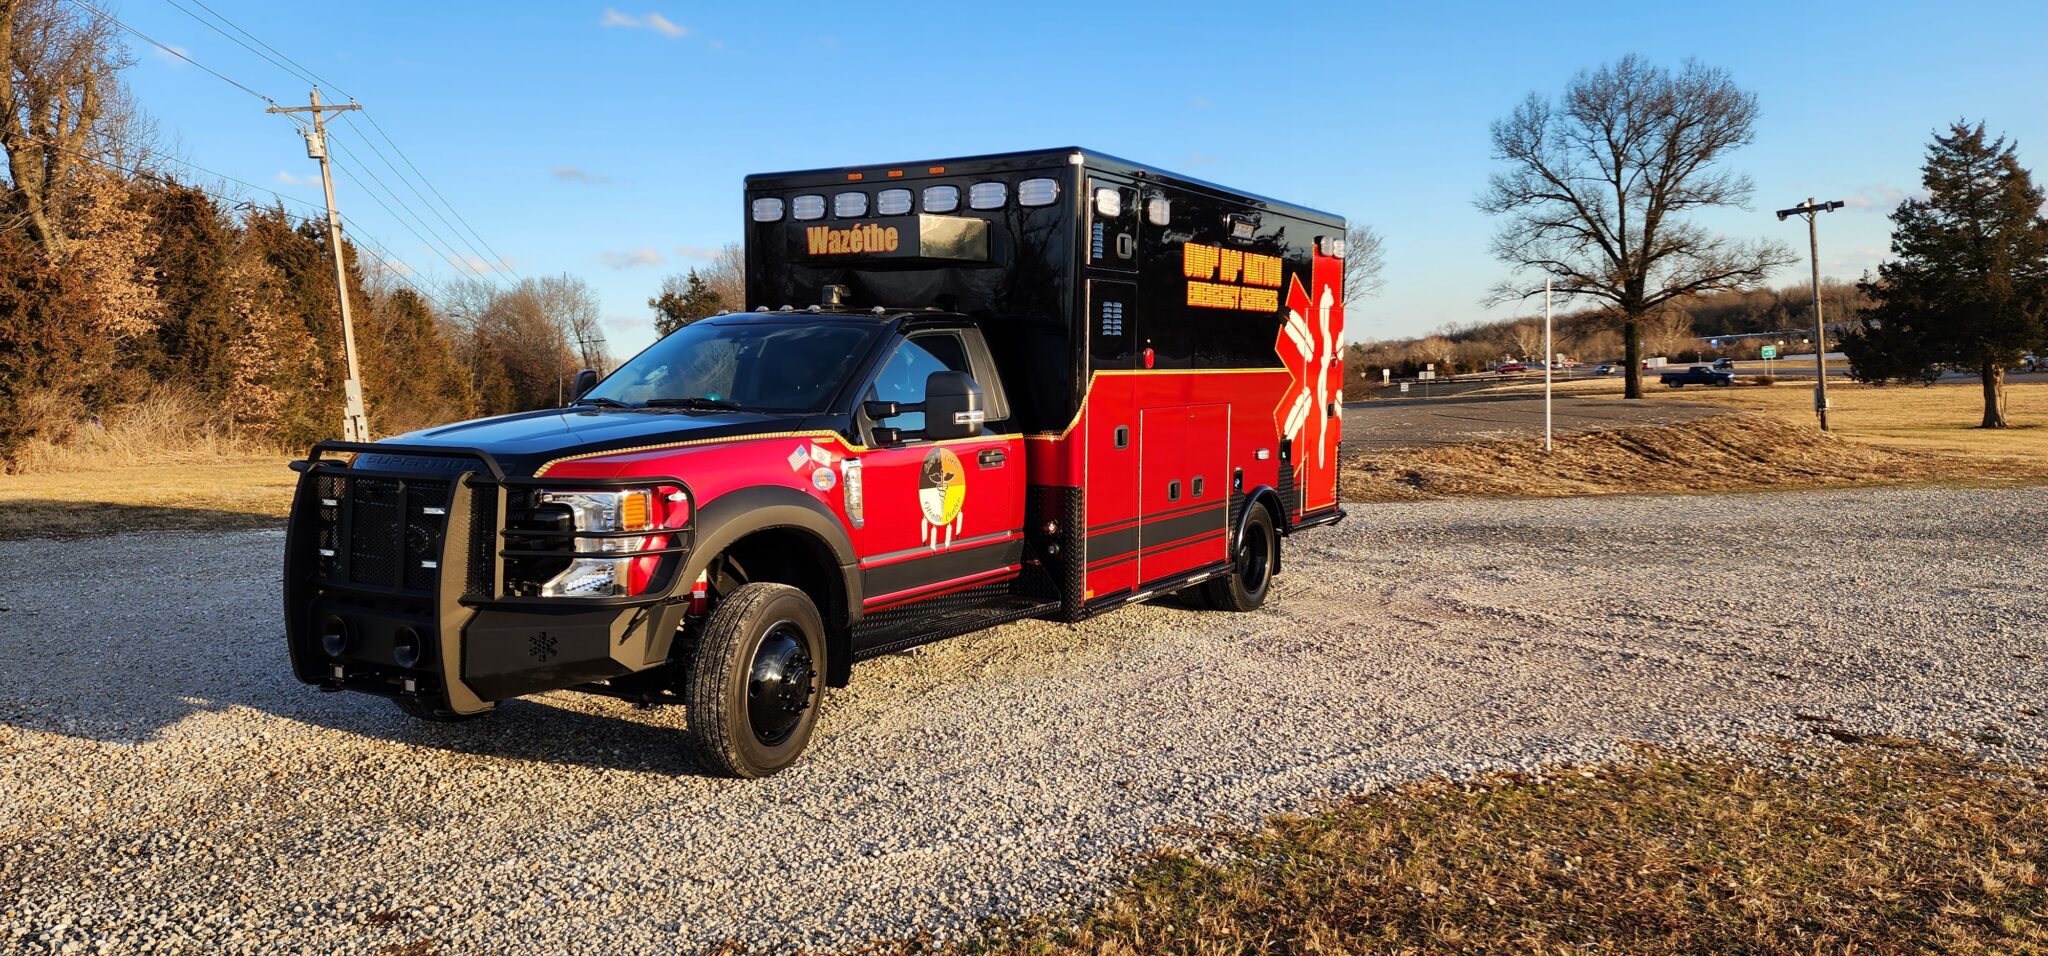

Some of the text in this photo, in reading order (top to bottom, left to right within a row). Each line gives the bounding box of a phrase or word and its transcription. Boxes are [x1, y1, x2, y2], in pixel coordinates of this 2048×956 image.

[806, 223, 898, 255] Wazéthe
[1187, 281, 1279, 312] EMERGENCY SERVICES
[367, 455, 431, 469] SUPER
